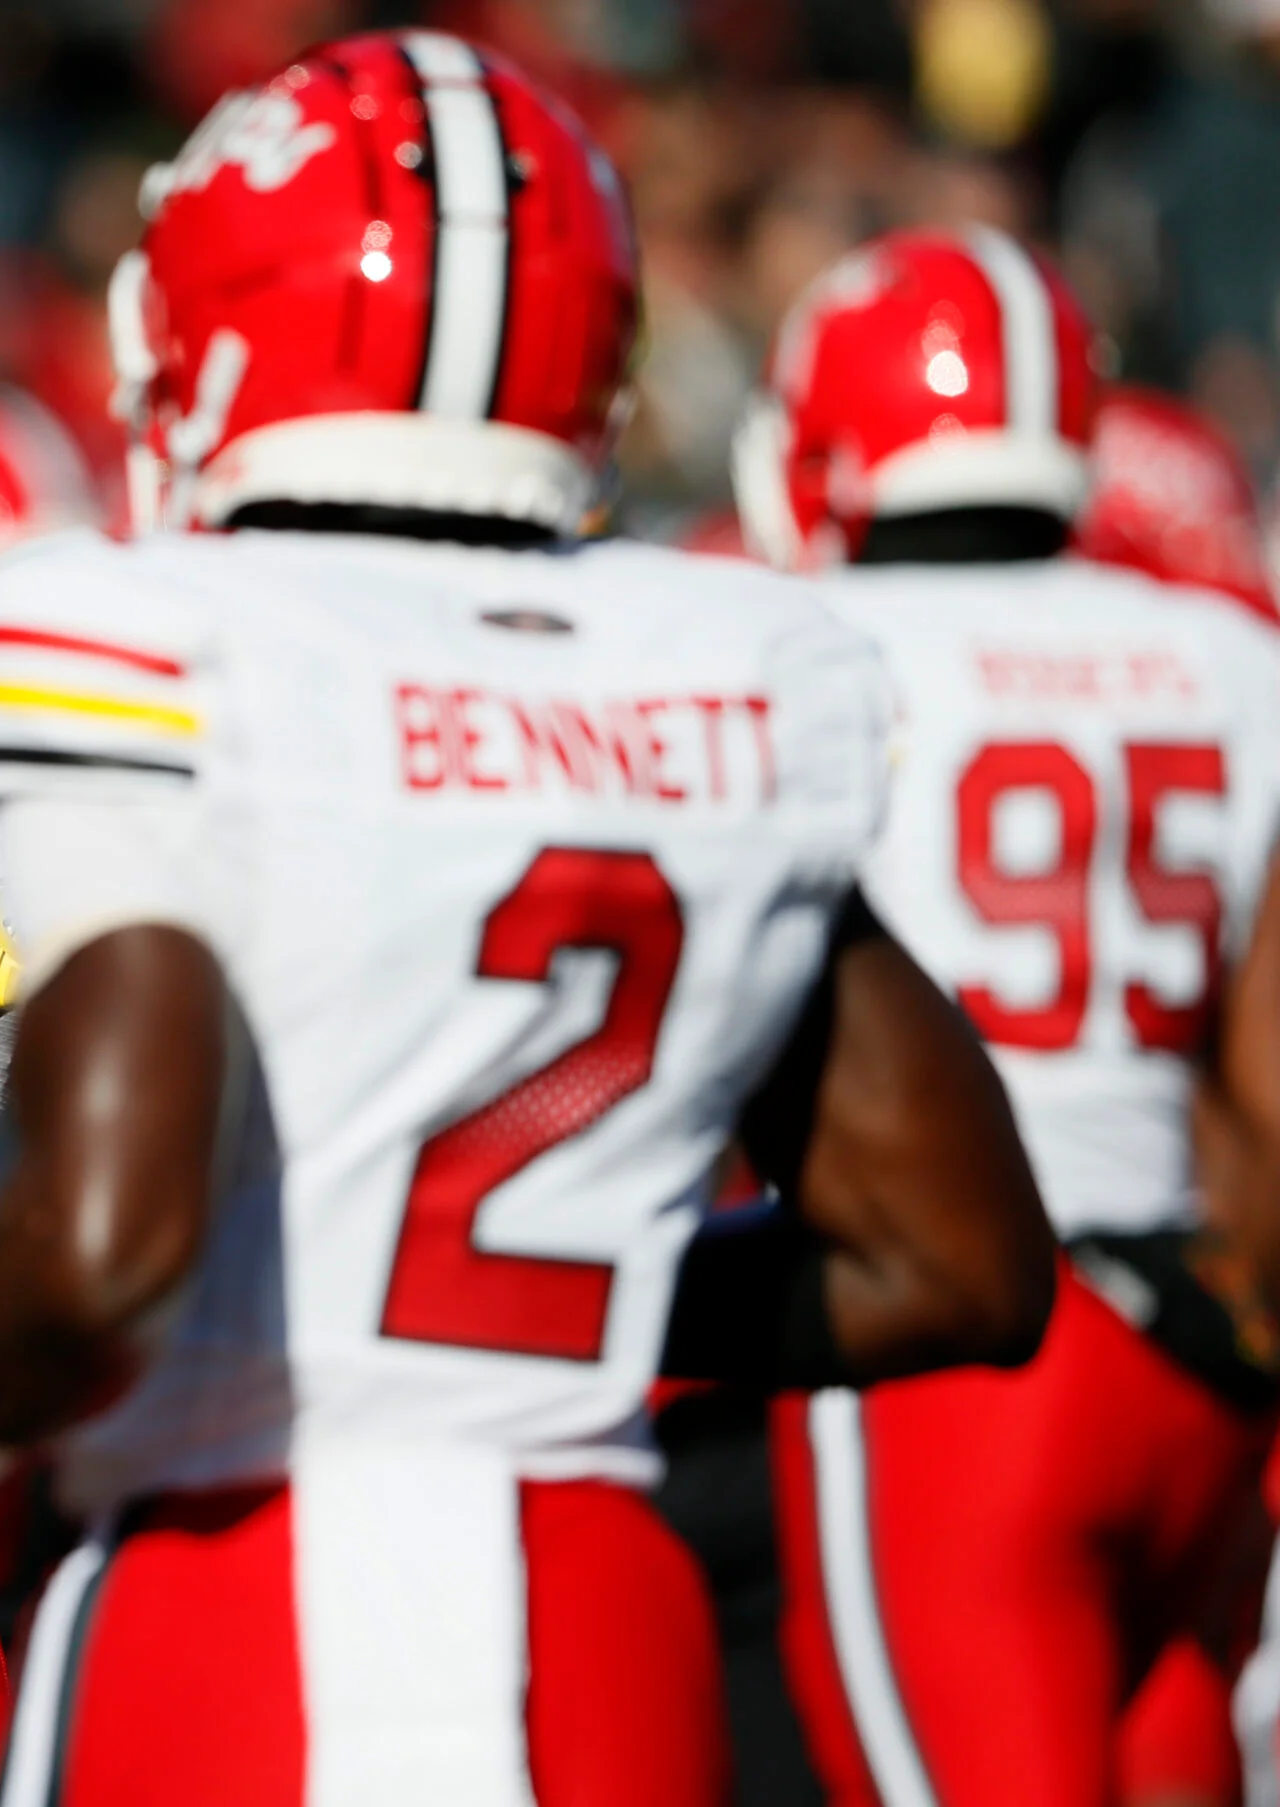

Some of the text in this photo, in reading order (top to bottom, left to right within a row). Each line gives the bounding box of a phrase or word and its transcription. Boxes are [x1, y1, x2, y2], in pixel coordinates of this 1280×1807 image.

[394, 684, 778, 808] BENNETT
[955, 738, 1227, 1054] 95
[380, 846, 686, 1362] 2
